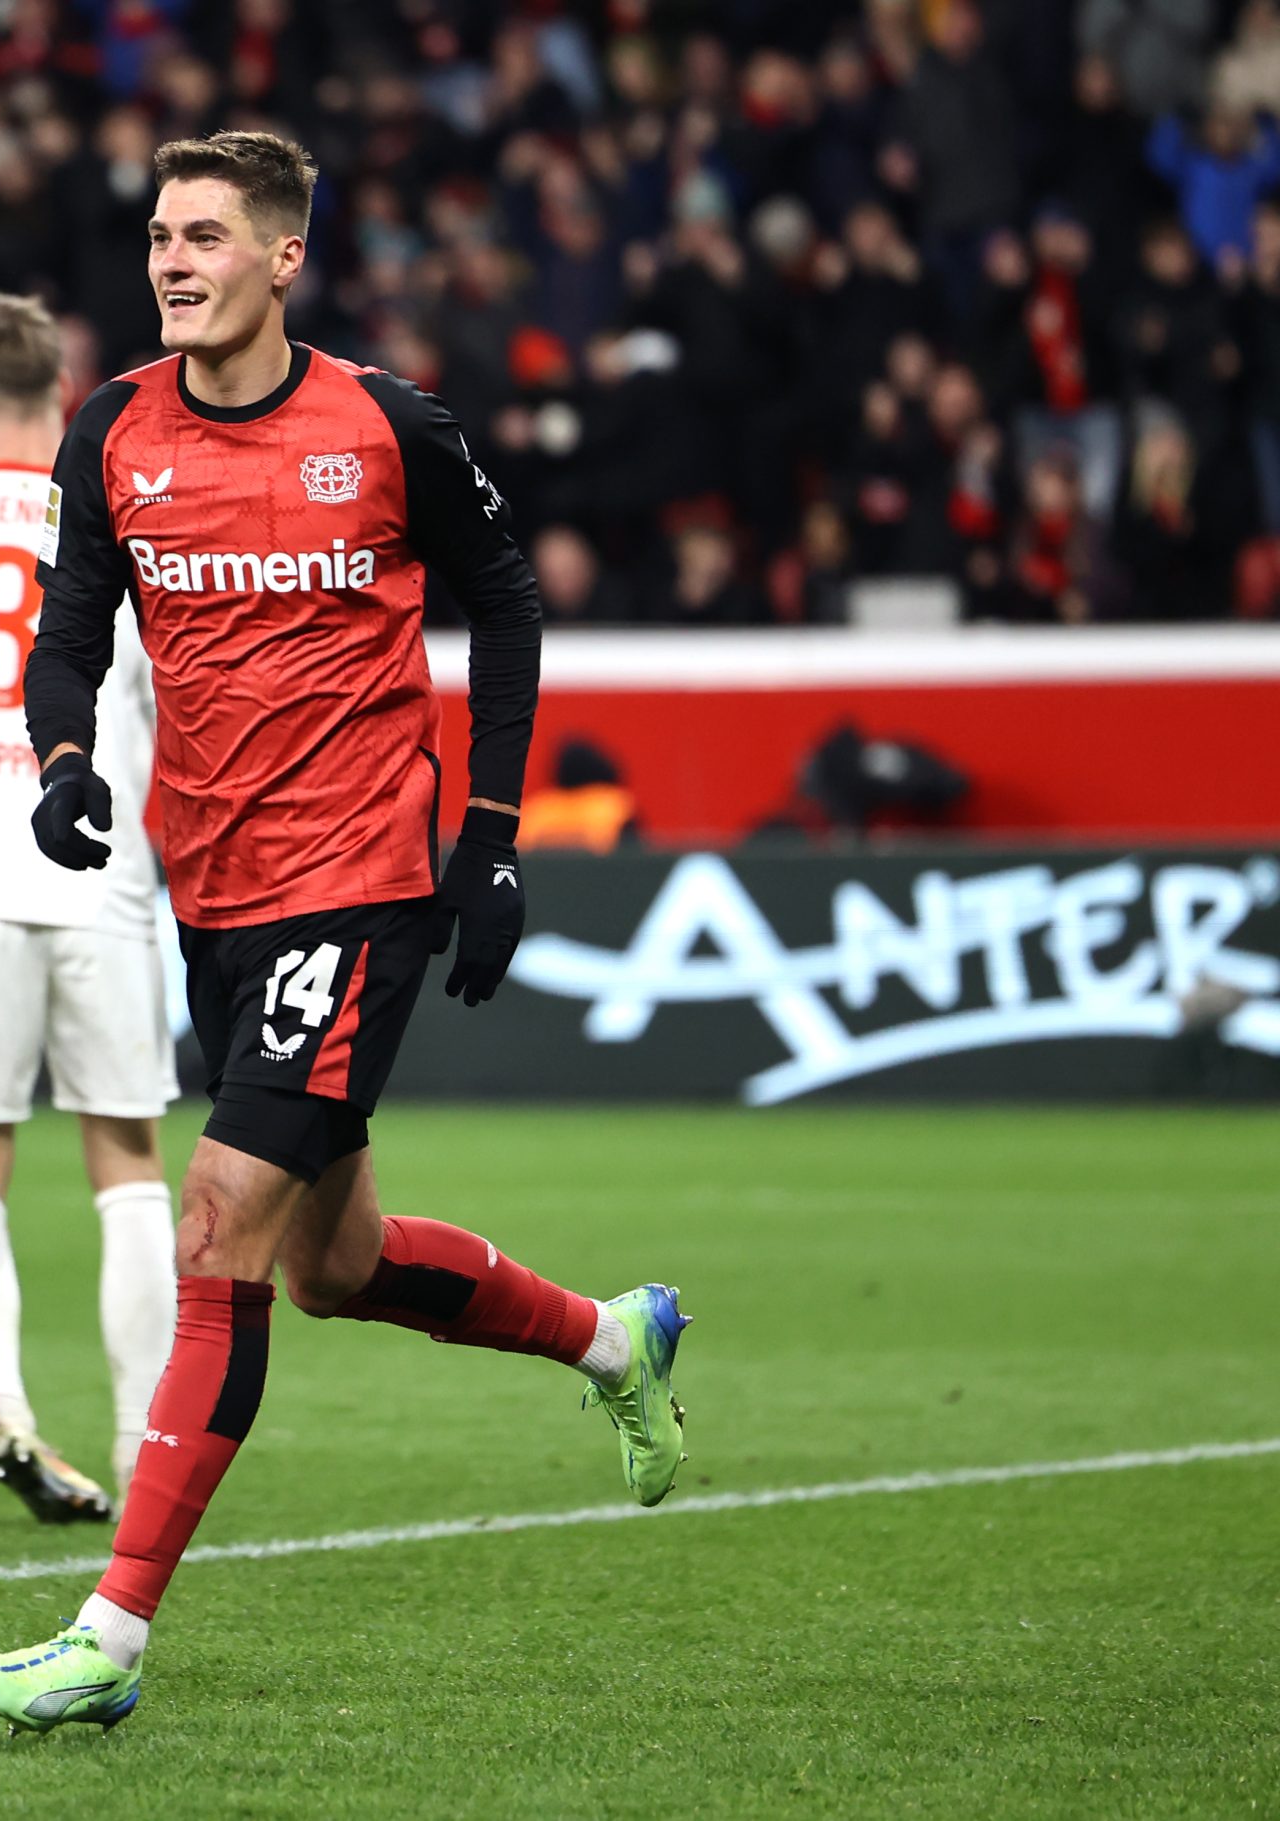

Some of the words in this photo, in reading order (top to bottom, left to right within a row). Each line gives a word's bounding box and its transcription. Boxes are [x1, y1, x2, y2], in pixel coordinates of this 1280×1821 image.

[134, 494, 173, 505] CASTORE
[128, 538, 375, 592] Barmenia
[263, 942, 342, 1028] 14
